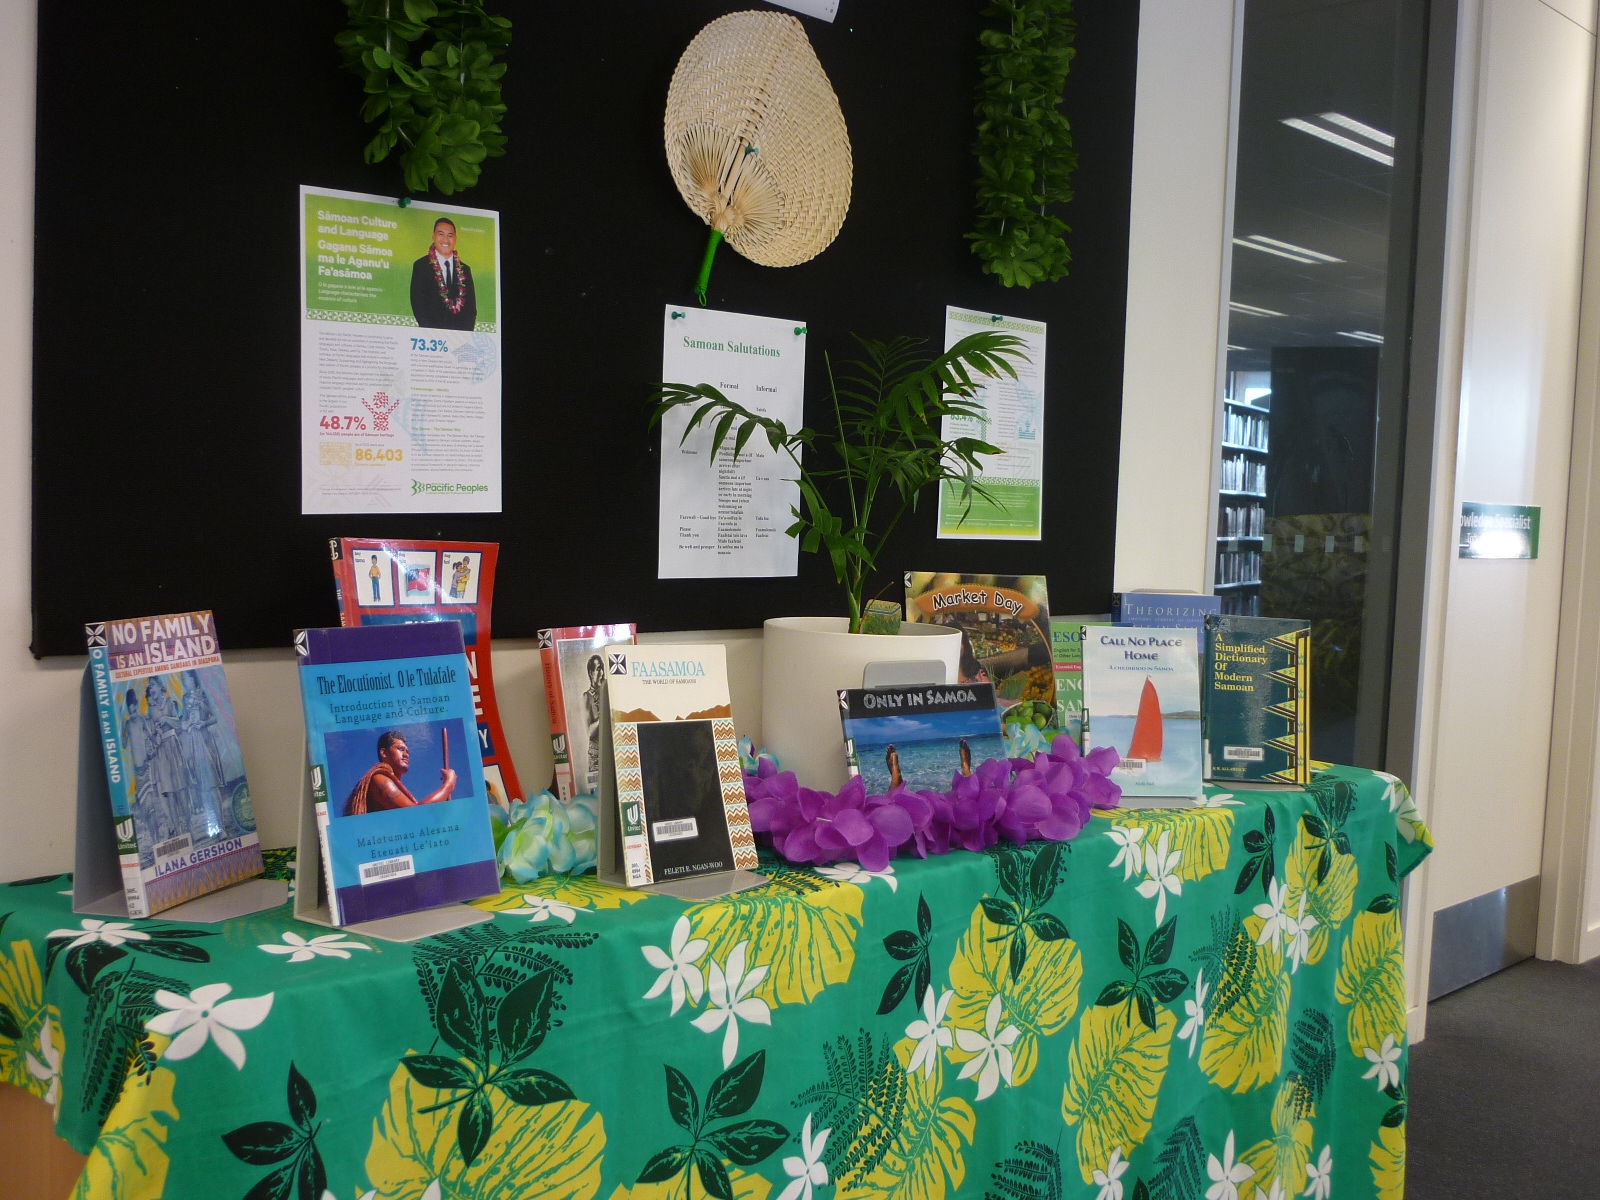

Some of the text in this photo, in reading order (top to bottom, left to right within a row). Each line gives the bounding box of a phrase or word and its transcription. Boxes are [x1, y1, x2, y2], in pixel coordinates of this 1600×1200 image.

[361, 216, 398, 229] Culture
[318, 225, 388, 241] and Language
[318, 240, 357, 254] Gagana
[318, 256, 335, 264] ma
[336, 255, 345, 264] le
[410, 338, 448, 352] 73.3%
[683, 336, 780, 357] Samoan Salutations
[320, 416, 366, 430] 48.7%
[355, 448, 403, 462] 86,403
[426, 483, 454, 491] Pacific
[456, 484, 488, 494] Peoples
[932, 588, 1022, 615] Market Day
[1125, 604, 1217, 616] THEORIZING
[112, 614, 210, 646] NO FAMILY
[1053, 631, 1080, 642] ESO
[1215, 633, 1223, 641] A
[1100, 636, 1182, 647] CALL NO PLACE
[1215, 643, 1266, 654] Simplified
[117, 636, 216, 669] IS AN ISLAND
[1124, 650, 1158, 660] HOME
[1215, 652, 1268, 665] Dictionary
[198, 656, 220, 665] DIASPORA
[1215, 662, 1227, 671] Of
[631, 660, 706, 677] FAASAMOA
[317, 666, 456, 695] The Elocutionist. O le Tulafale
[1214, 672, 1253, 682] Modern
[94, 663, 110, 706] FAMILY
[1214, 682, 1254, 692] Samoan
[544, 662, 553, 688] History
[549, 698, 557, 724] Samoa
[864, 690, 977, 709] ONLY IN SAMOA
[330, 694, 450, 714] Introduction to Samoan
[101, 710, 108, 718] IS
[335, 706, 448, 724] Language and Culture.
[102, 721, 111, 734] AN
[105, 738, 121, 783] ISLAND
[357, 824, 460, 847] Malotumau Alesana
[371, 839, 450, 859] Eteuati Le'iato
[154, 838, 242, 877] ILANA GERSHON
[692, 861, 723, 871] NGAN-WOO
